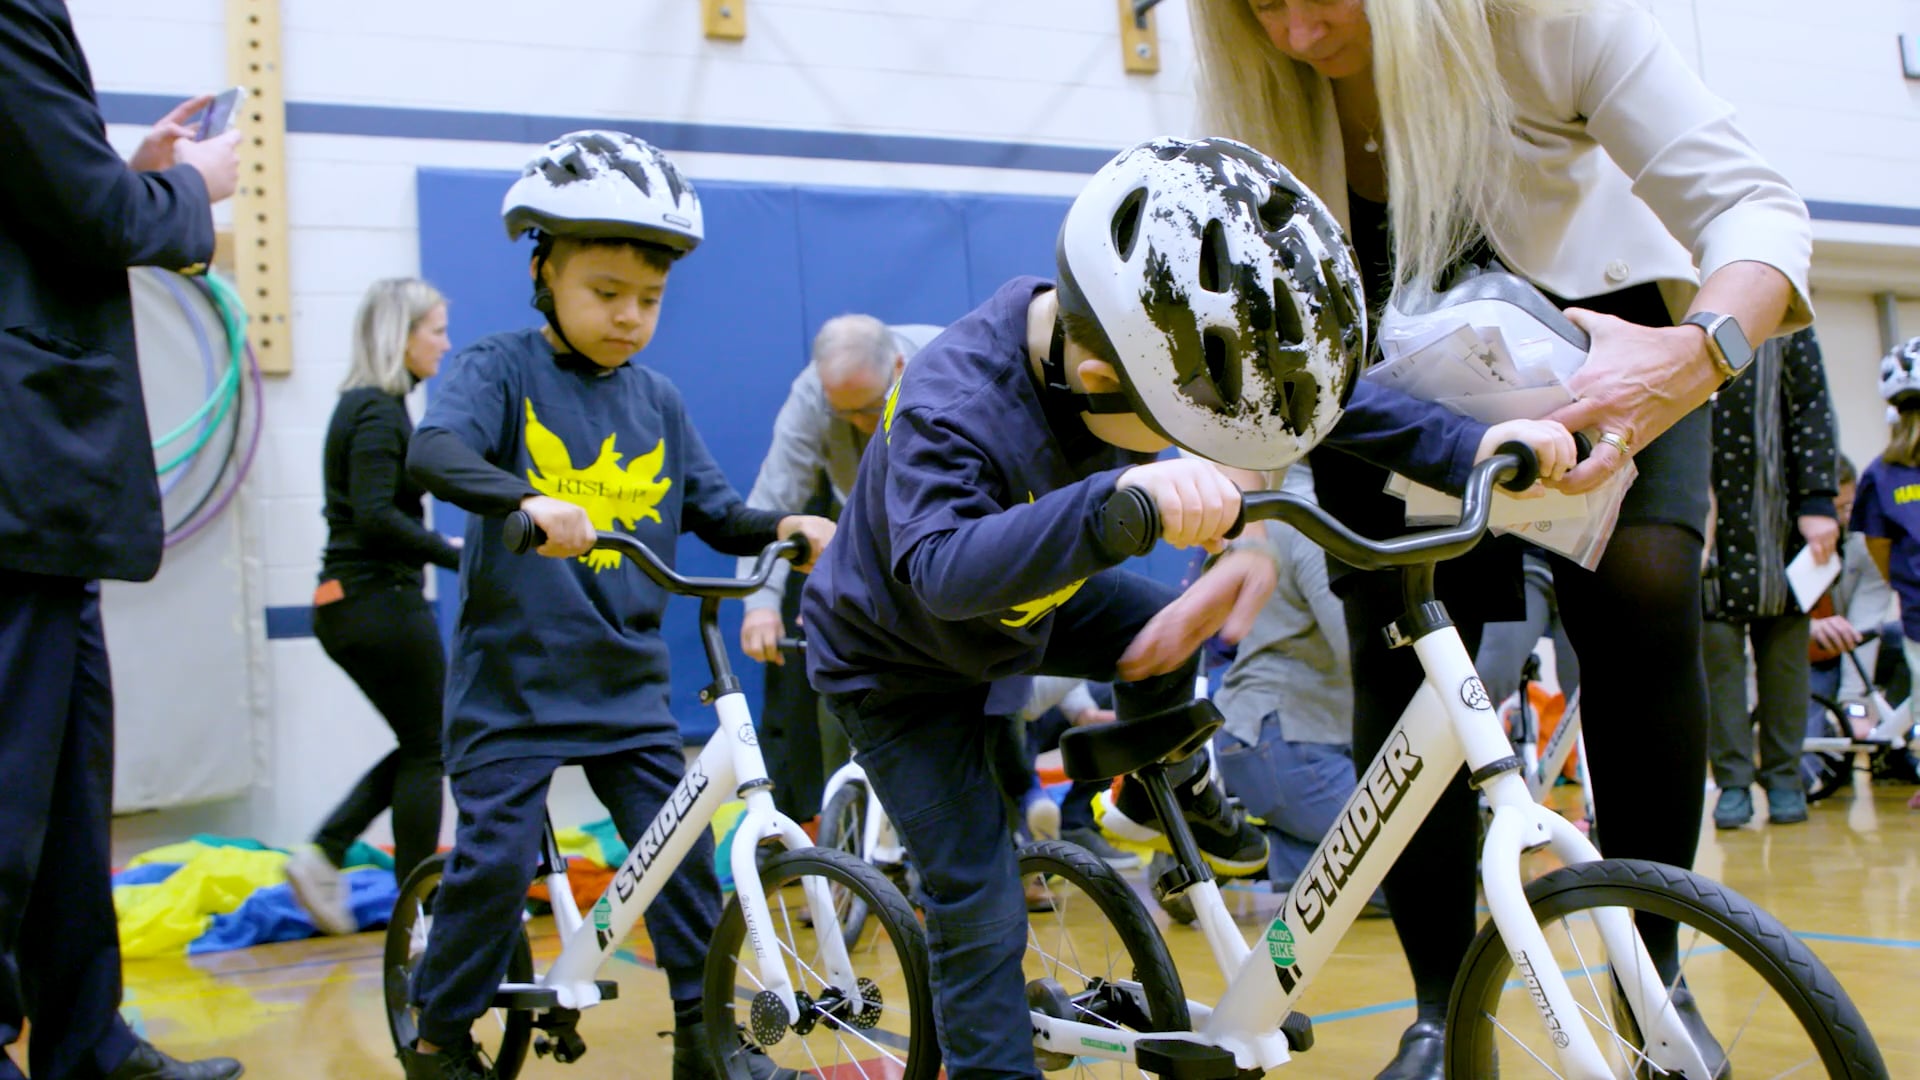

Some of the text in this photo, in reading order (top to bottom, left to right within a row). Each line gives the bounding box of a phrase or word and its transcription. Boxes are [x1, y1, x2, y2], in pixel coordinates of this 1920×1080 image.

[557, 479, 609, 497] RISE
[616, 759, 709, 902] STRIDER
[1295, 730, 1423, 934] STRIDER
[1269, 943, 1294, 956] BIKE
[1514, 950, 1561, 1031] STRIDER
